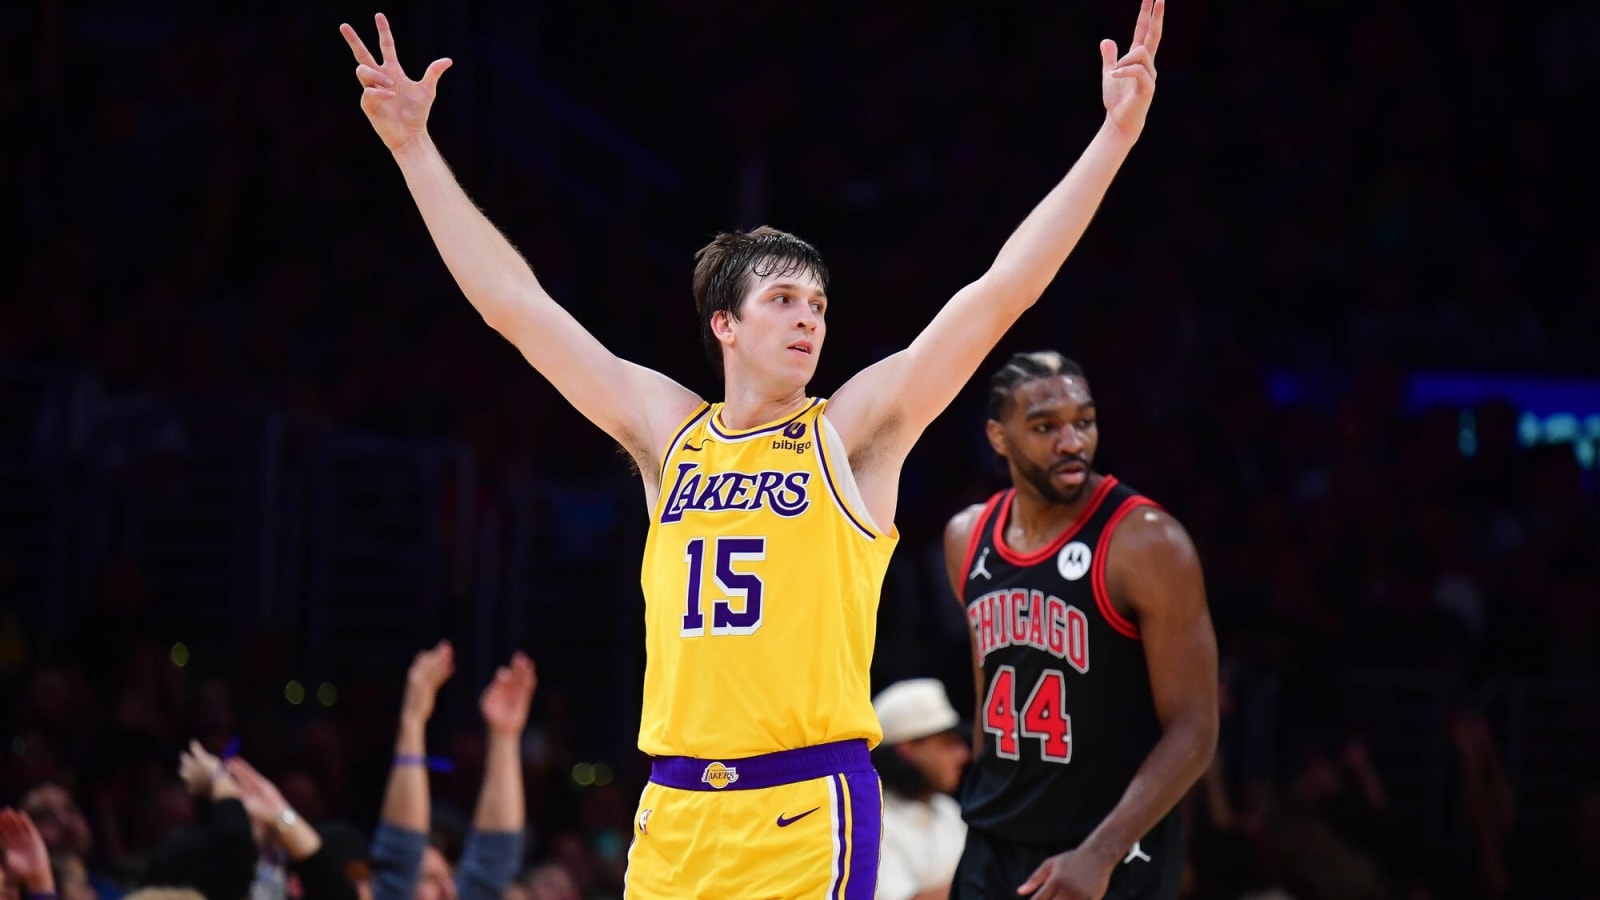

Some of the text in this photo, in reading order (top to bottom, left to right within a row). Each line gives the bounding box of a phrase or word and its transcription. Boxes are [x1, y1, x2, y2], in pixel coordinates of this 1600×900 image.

[772, 440, 811, 454] bibigo
[660, 462, 811, 525] LAKERS
[680, 536, 766, 637] 15
[983, 665, 1073, 763] 44
